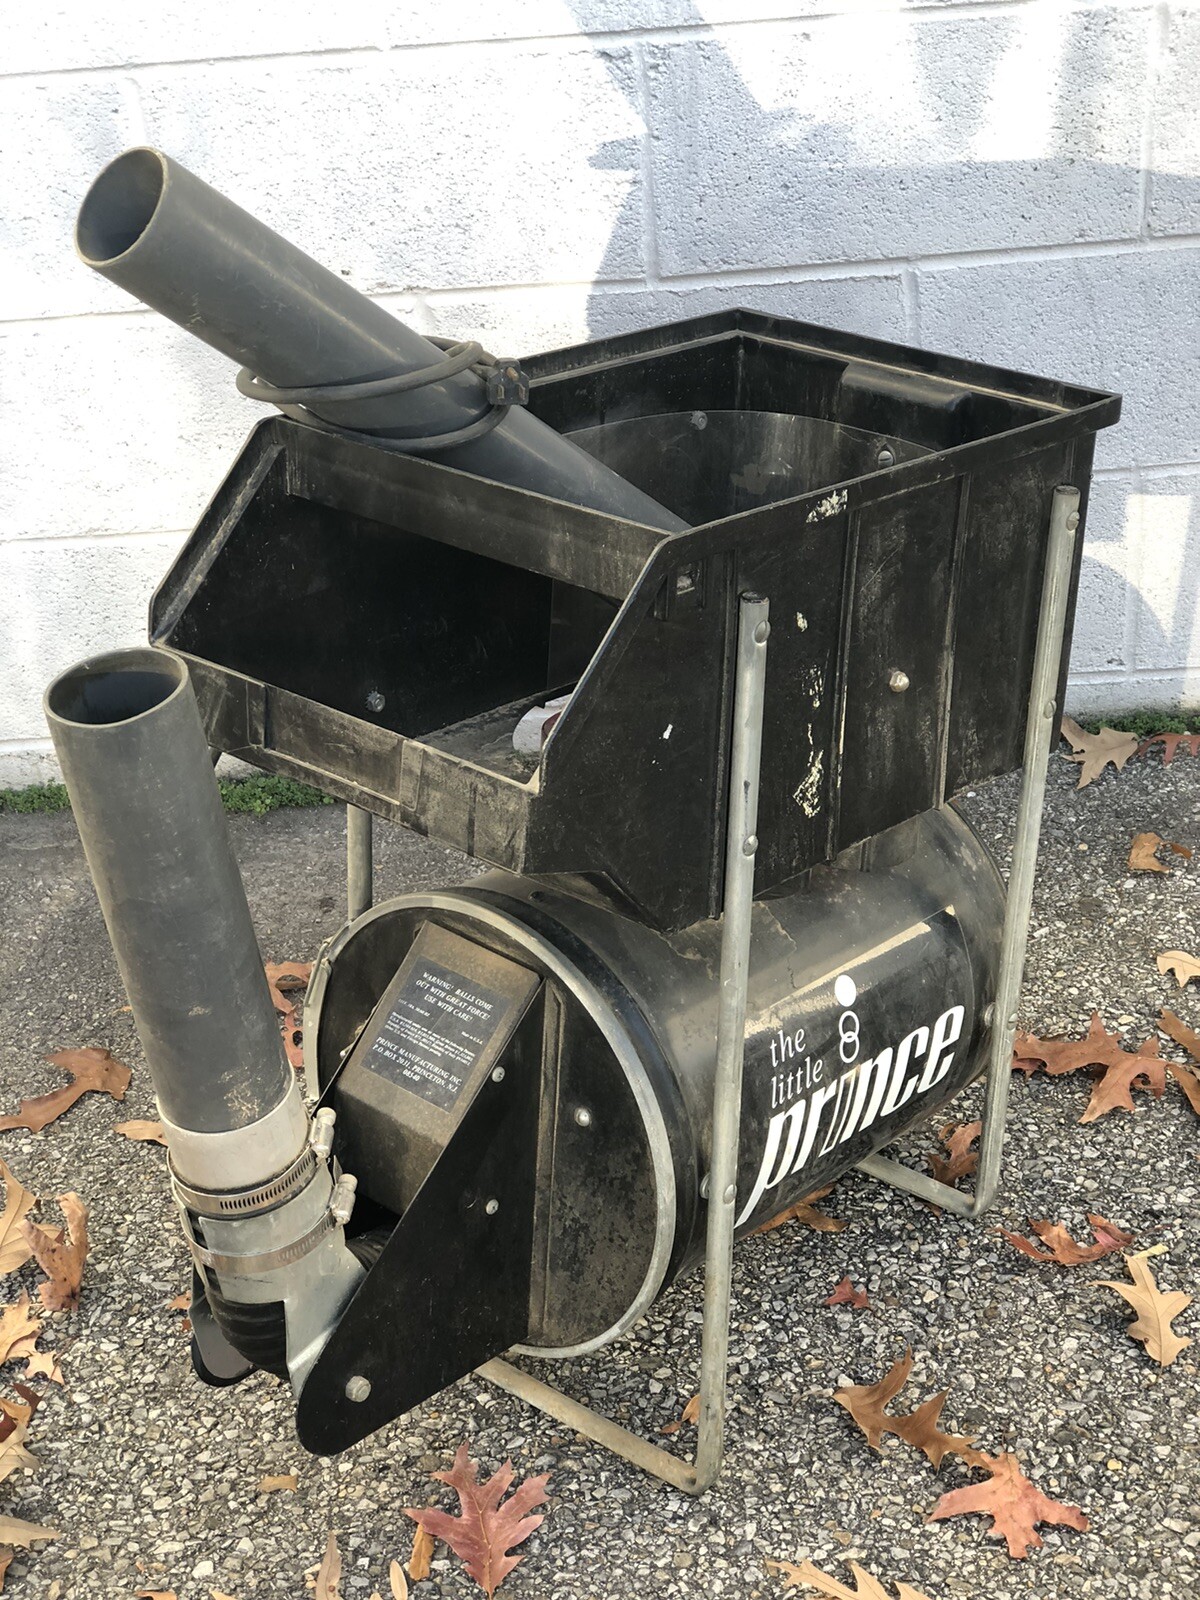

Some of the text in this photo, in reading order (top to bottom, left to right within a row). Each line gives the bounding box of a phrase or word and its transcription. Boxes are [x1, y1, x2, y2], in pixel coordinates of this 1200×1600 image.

[415, 979, 430, 989] OUT
[429, 986, 446, 998] WITH
[445, 994, 467, 1008] GREAT
[466, 1005, 490, 1020] FORCE!
[422, 971, 493, 1010] WARNING! BALLS COME
[423, 993, 437, 1003] USE
[436, 1000, 453, 1012] WITH
[452, 1008, 473, 1021] CARE!
[372, 1043, 383, 1053] P.O.
[383, 1049, 397, 1060] BOX
[411, 1064, 446, 1087] PRINCETON,
[446, 1083, 457, 1093] N.J.
[375, 1036, 398, 1051] PRINCE
[398, 1047, 449, 1078] MANUFACTURING
[770, 1028, 807, 1067] the
[771, 1057, 823, 1109] little
